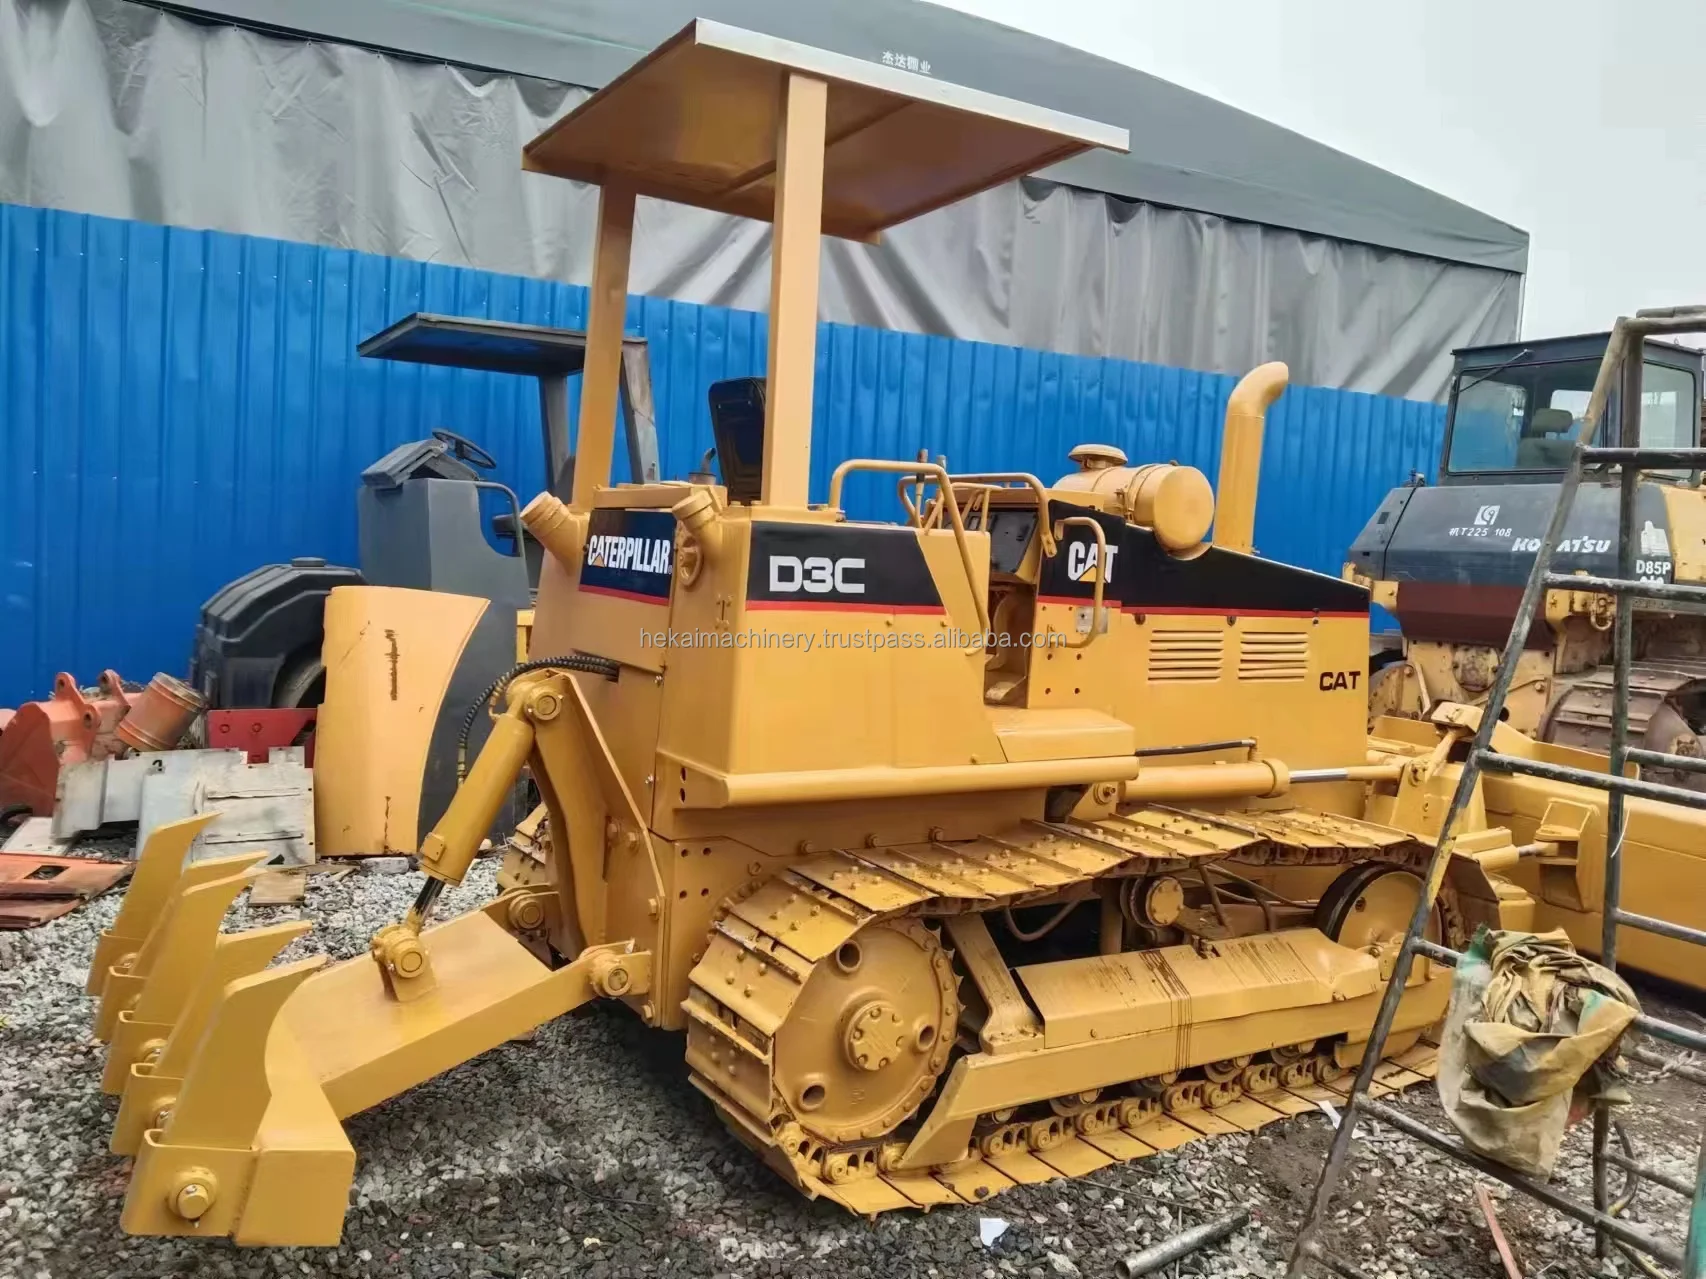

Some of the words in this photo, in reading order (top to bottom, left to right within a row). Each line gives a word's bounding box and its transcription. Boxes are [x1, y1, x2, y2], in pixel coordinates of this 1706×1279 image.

[1494, 528, 1512, 537] 108
[587, 534, 671, 575] CATERPILLAR
[1511, 536, 1611, 553] KOATSU
[1067, 541, 1118, 583] CAT
[1636, 559, 1671, 575] D85P
[769, 555, 865, 593] D3C
[1319, 671, 1361, 691] CAT
